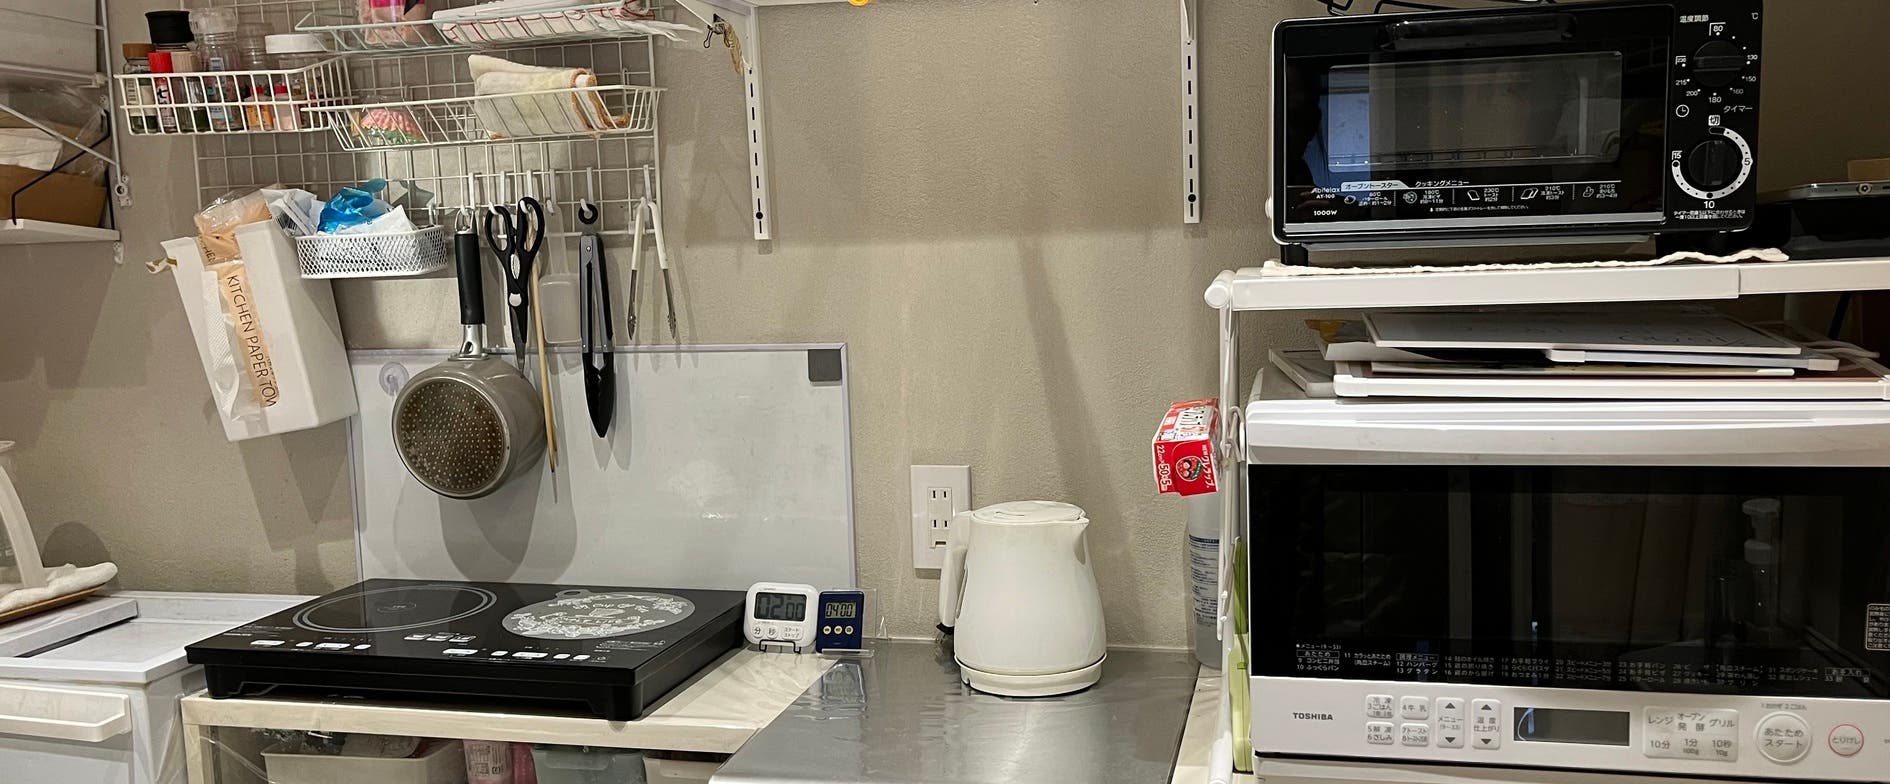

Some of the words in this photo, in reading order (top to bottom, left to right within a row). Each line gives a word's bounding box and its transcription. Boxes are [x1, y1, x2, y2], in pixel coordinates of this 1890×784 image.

[1724, 105, 1753, 114] タイマー
[1709, 116, 1720, 124] 切
[1674, 152, 1682, 160] 15
[1345, 182, 1398, 190] オーブントースター
[1415, 180, 1469, 188] クッキングメニュー
[1704, 200, 1715, 208] 10
[227, 275, 255, 333] KITCHEN
[246, 336, 269, 378] PAPER
[1292, 712, 1333, 721] TOSHIBA
[1648, 715, 1673, 725] レンジ
[1677, 712, 1705, 721] オーブン
[1709, 719, 1736, 728] グリル
[1764, 728, 1804, 737] あたため
[1650, 740, 1671, 750] 10分
[1684, 738, 1698, 747] 1分
[1712, 740, 1733, 748] 10秒
[1764, 739, 1803, 748] スタート
[1832, 737, 1860, 745] とりけし
